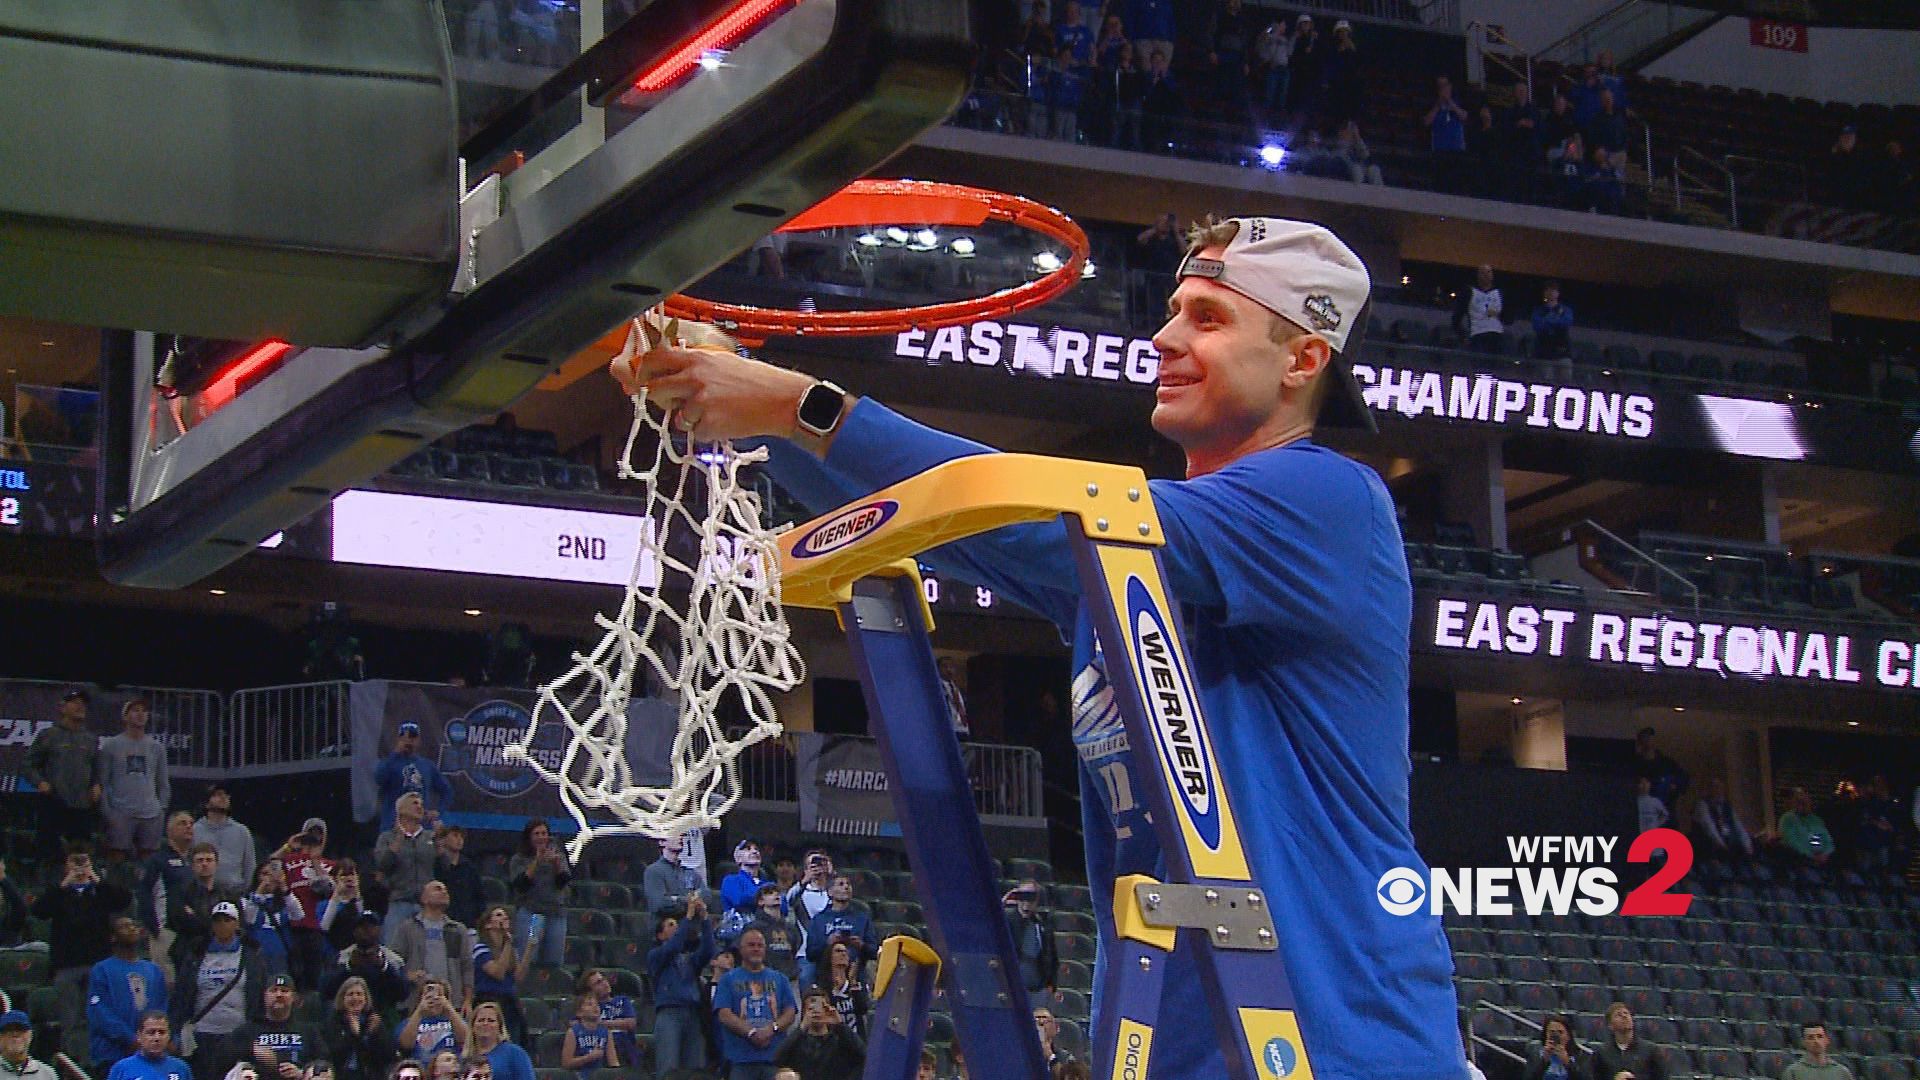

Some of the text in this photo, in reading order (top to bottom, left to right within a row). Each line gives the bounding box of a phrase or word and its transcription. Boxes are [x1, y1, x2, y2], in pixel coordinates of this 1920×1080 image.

[1762, 24, 1797, 48] 109
[896, 320, 1040, 369] EAST
[1352, 364, 1655, 438] CHAMPIONS
[558, 534, 606, 560] 2ND
[812, 510, 877, 550] WERNER
[1434, 599, 1920, 688] EAST REGIONAL C
[1141, 631, 1206, 801] WERNER
[258, 1033, 303, 1045] DUKE
